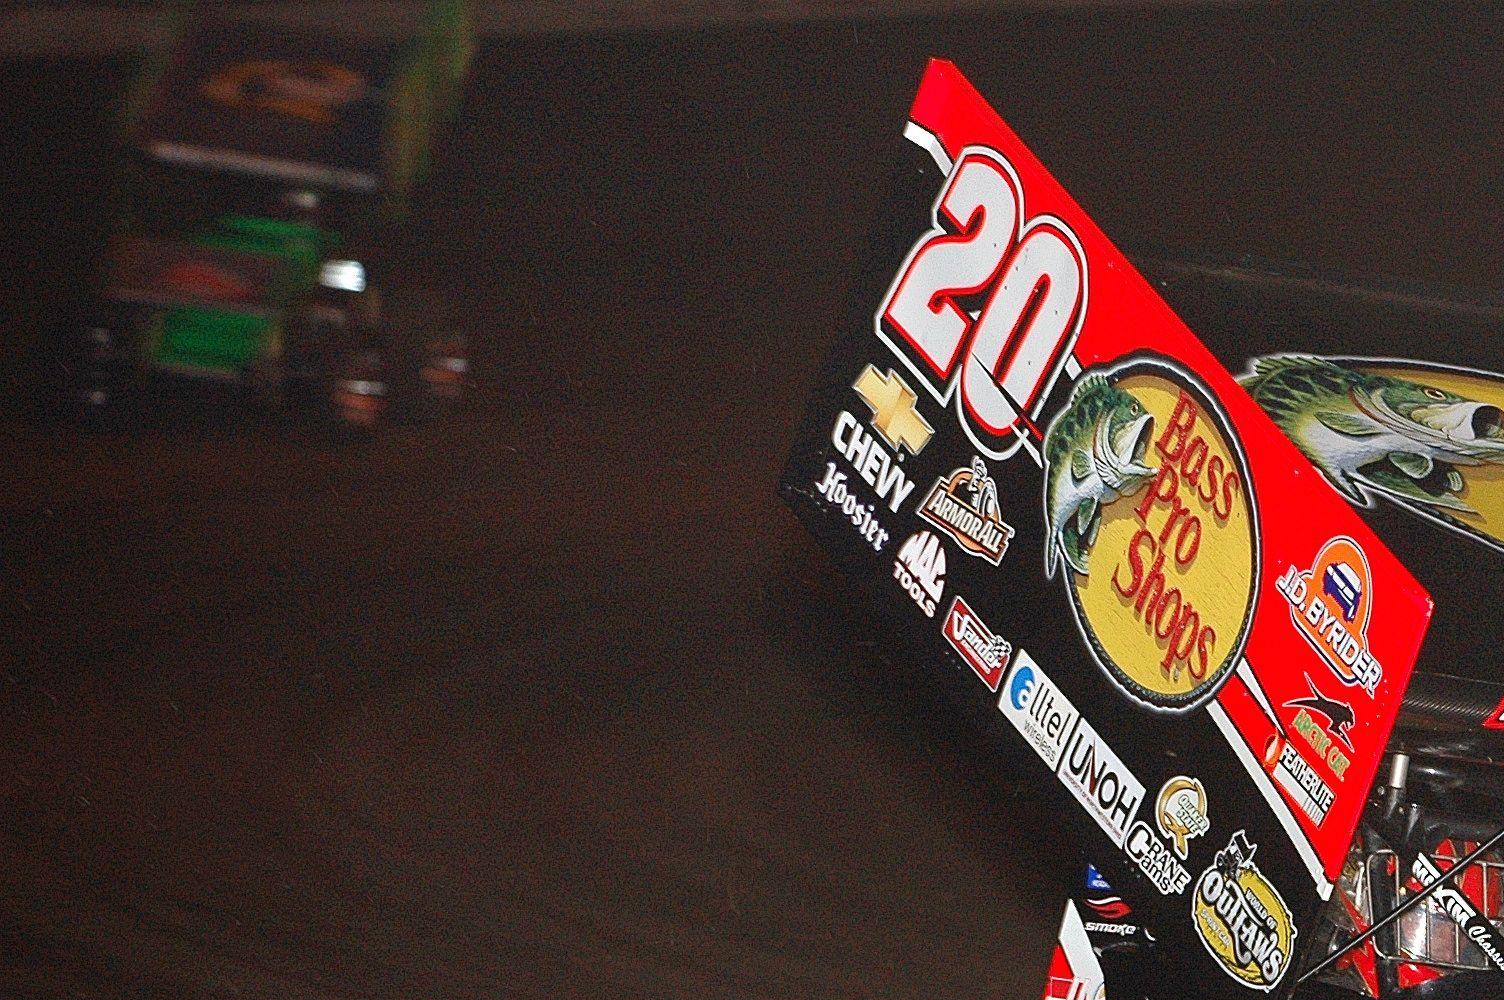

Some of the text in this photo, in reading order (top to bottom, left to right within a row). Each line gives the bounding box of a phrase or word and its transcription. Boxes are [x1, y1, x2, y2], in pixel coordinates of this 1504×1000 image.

[879, 146, 1089, 455] 20
[832, 410, 916, 514] CHEVY
[1155, 387, 1240, 521] Bass
[815, 462, 889, 551] Hoosier
[1133, 456, 1202, 566] Pro
[893, 561, 936, 619] TOOLS
[899, 530, 946, 603] MAC
[1112, 528, 1217, 681] Shops
[1276, 565, 1383, 700] J.D. BYRIDER
[1010, 666, 1071, 747] alltel
[1023, 719, 1057, 764] wireless
[1068, 732, 1138, 832] UNOH
[1127, 822, 1191, 893] CRANE
